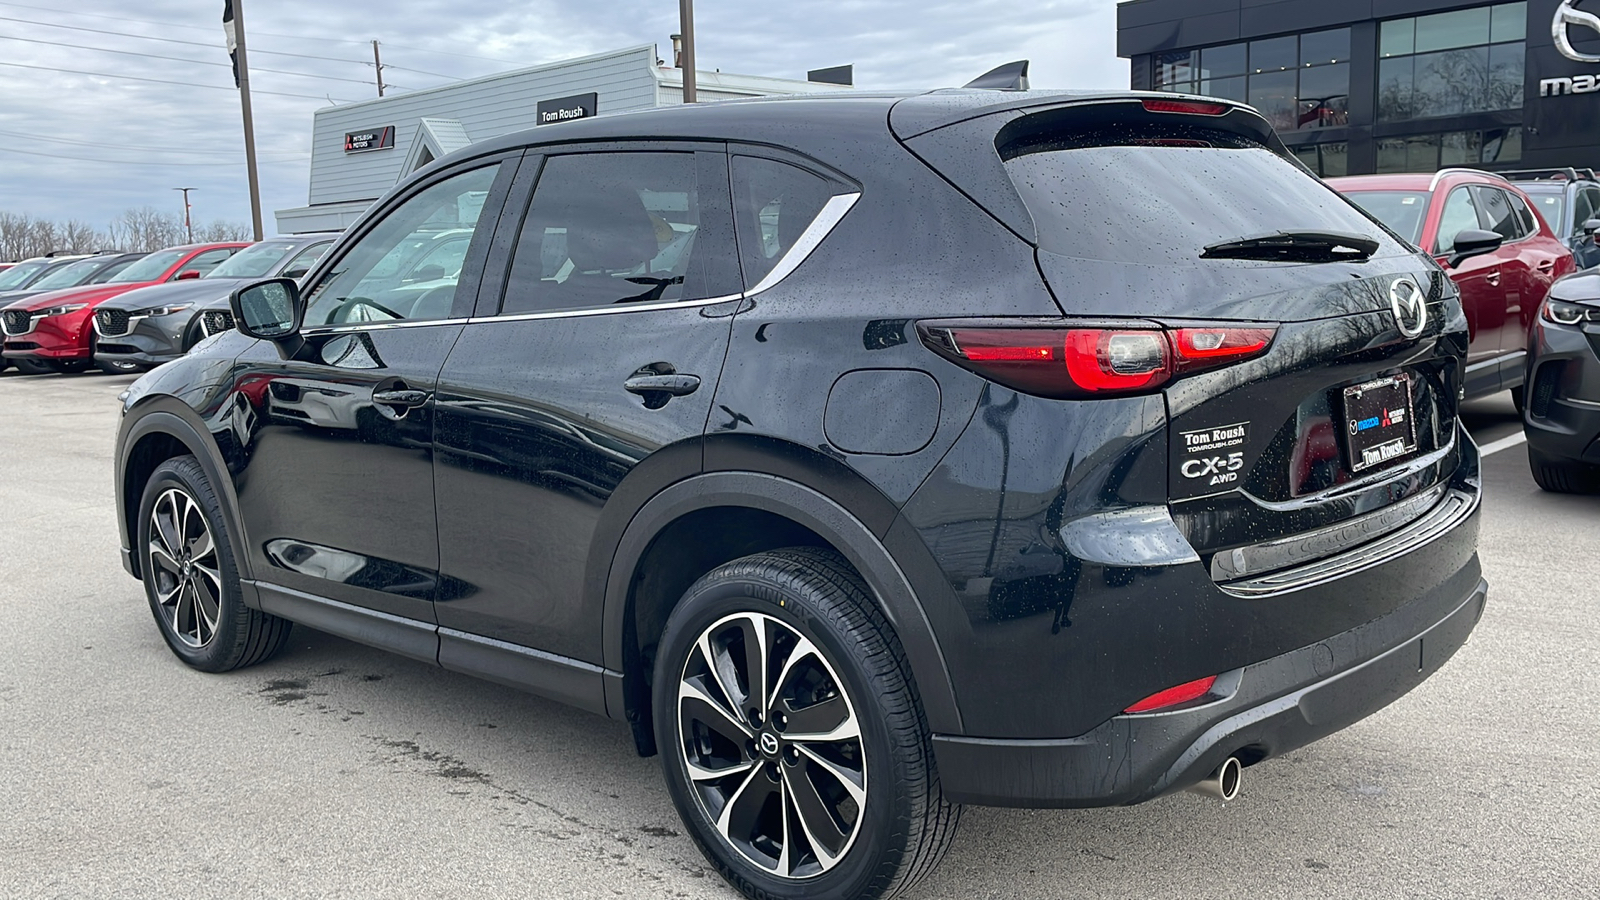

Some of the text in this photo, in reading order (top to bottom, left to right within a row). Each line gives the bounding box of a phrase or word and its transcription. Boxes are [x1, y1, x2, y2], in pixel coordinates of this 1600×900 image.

[1540, 74, 1600, 97] ma
[542, 106, 583, 122] Tom Roush
[1357, 416, 1380, 431] mazda
[1184, 425, 1246, 446] Tom Roush
[1187, 438, 1243, 453] TOMROUSH.COM
[1363, 439, 1405, 466] Tom Roush
[1180, 451, 1244, 478] CX-5
[1209, 472, 1238, 486] AWD
